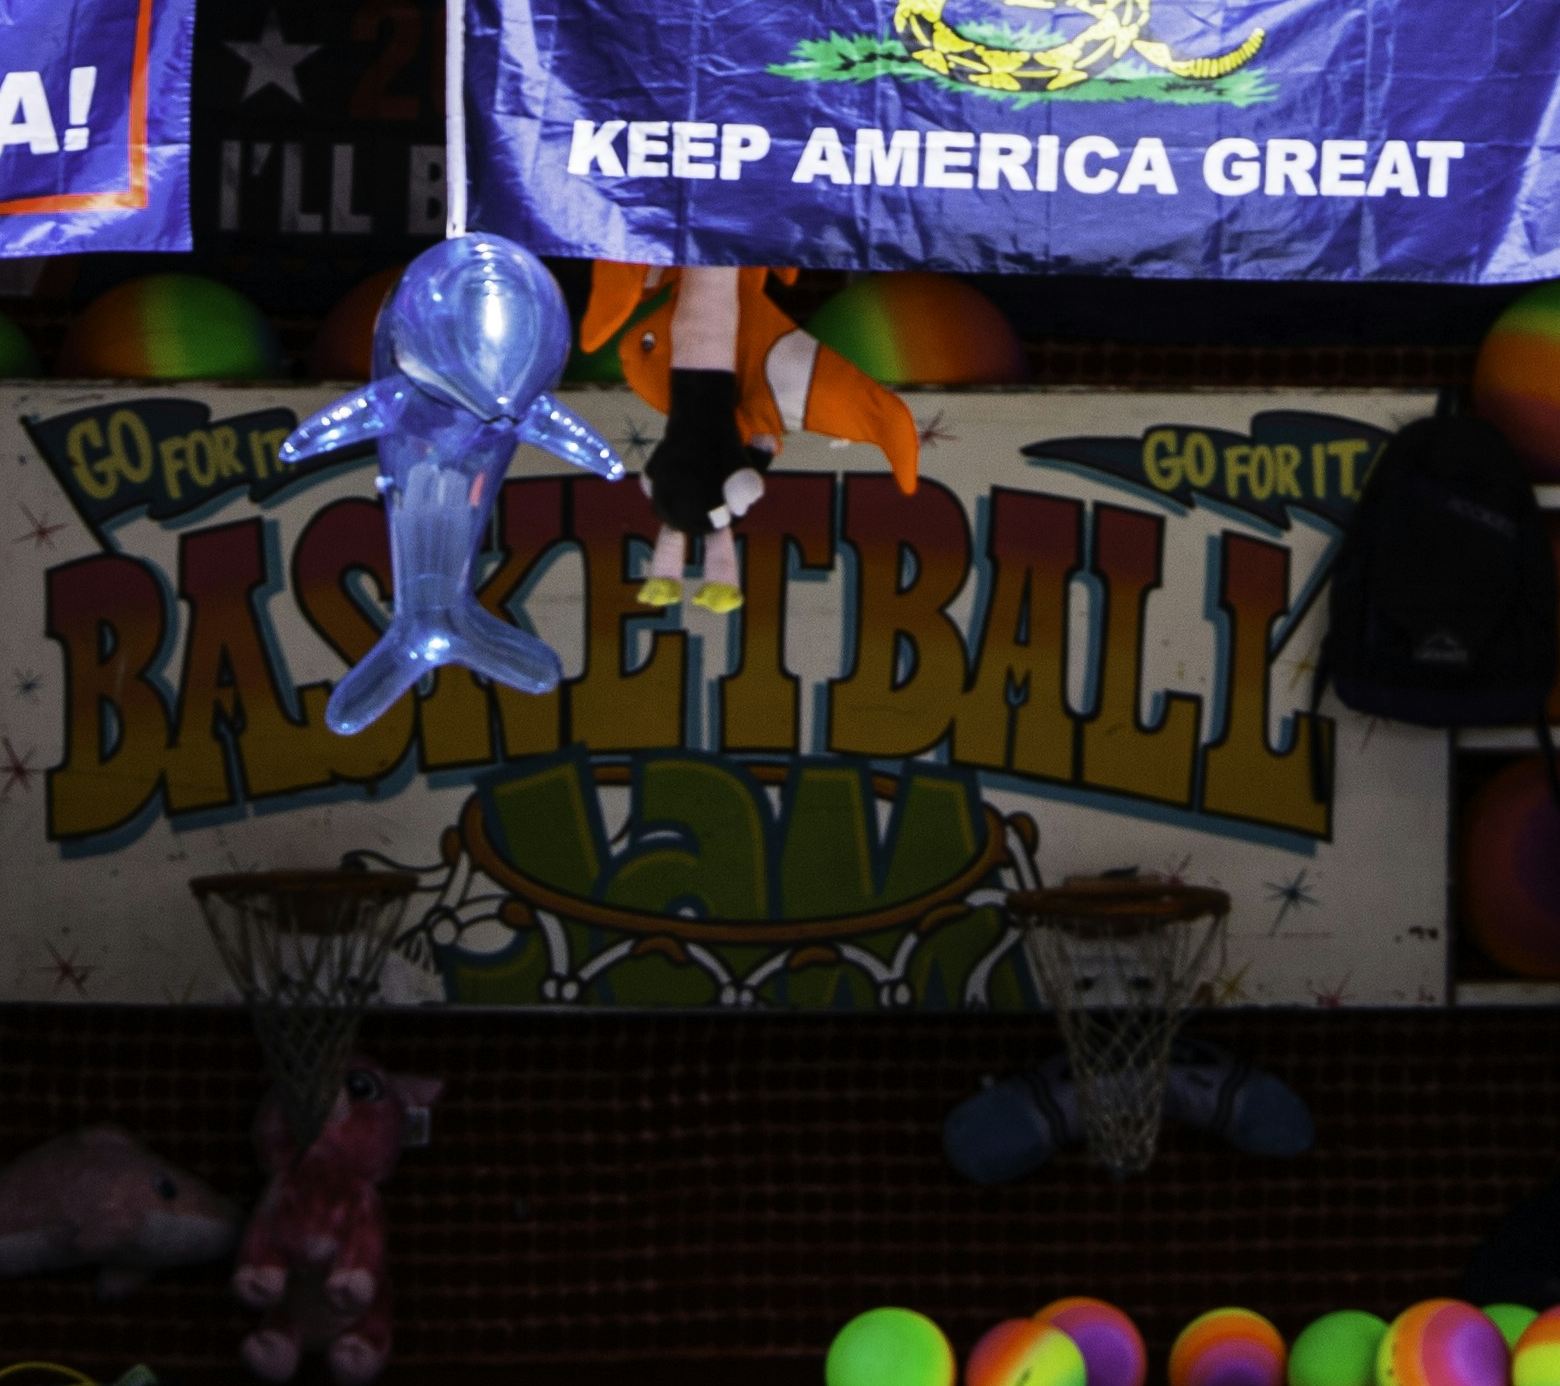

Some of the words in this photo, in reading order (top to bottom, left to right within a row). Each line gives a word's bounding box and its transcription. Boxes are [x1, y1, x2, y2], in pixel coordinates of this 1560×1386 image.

[567, 120, 771, 182] KEEP
[792, 131, 1179, 196] AMERICA
[1205, 138, 1465, 197] GREAT
[67, 410, 154, 500] GO
[162, 427, 246, 497] FOR
[1141, 429, 1217, 492] GO
[1225, 446, 1303, 501] FOR
[43, 470, 1336, 845] BASKETBALL
